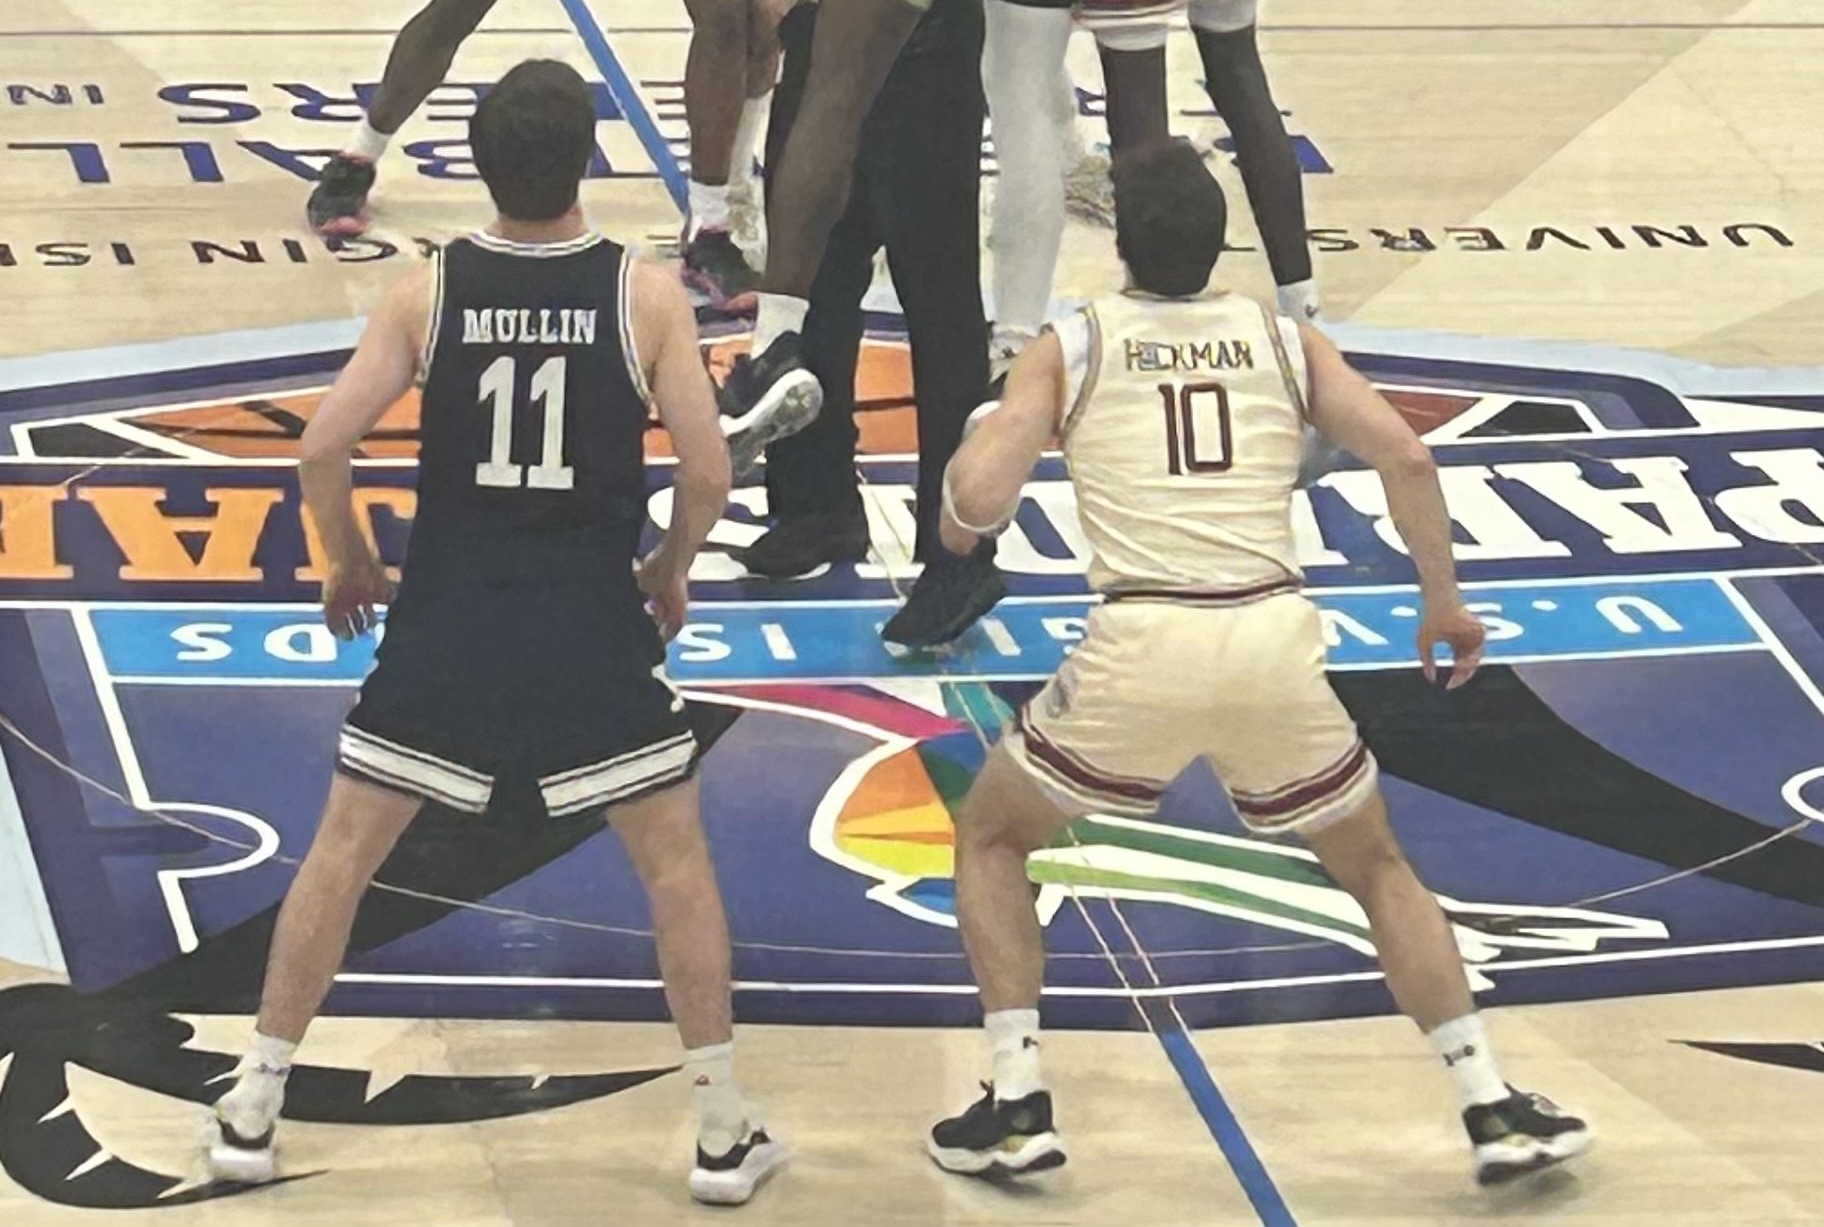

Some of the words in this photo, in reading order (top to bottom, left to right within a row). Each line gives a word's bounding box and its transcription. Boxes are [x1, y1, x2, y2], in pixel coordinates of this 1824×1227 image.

[461, 308, 598, 345] MULLIN
[475, 355, 574, 490] 11
[1158, 382, 1233, 476] 10
